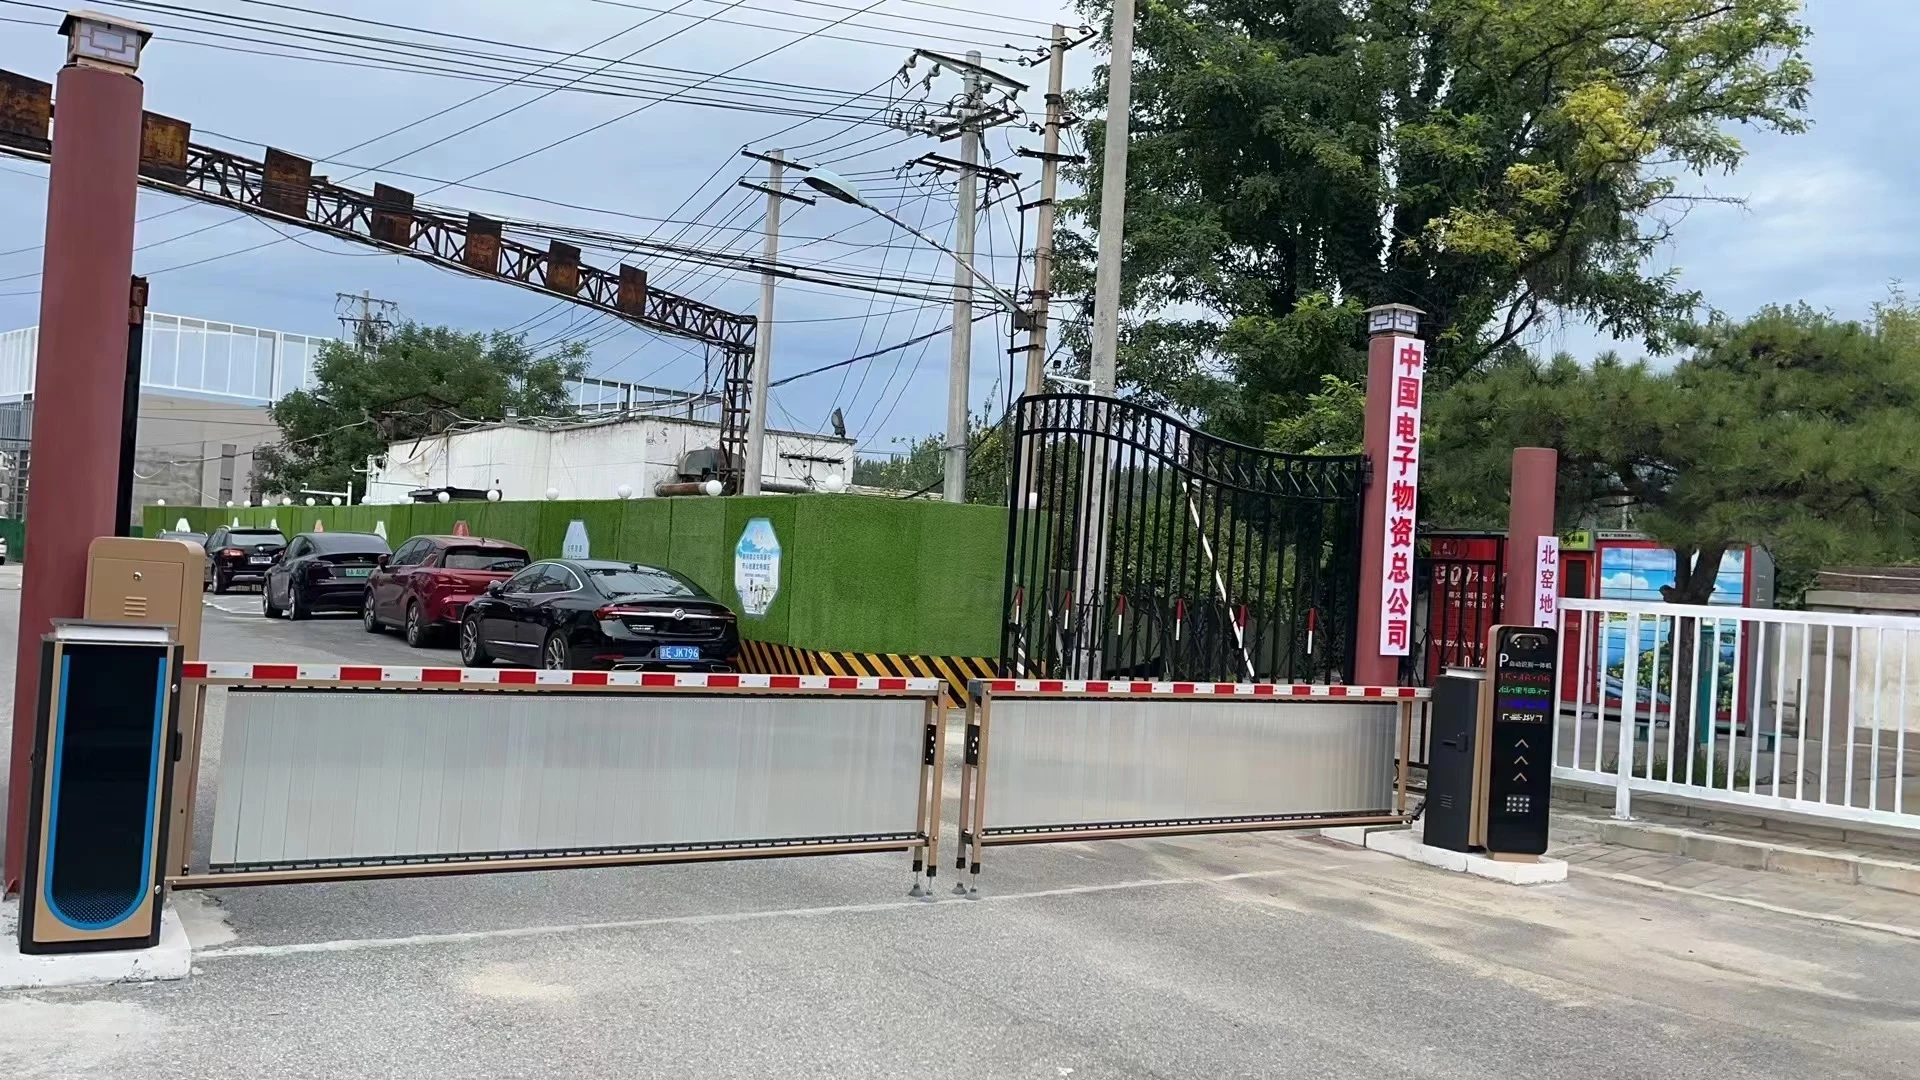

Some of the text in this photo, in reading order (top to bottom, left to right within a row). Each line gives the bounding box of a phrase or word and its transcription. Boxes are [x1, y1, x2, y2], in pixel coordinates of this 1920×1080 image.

[1387, 343, 1421, 650] 中国电子物资总公司
[1499, 653, 1509, 668] P
[1509, 660, 1552, 669] 自动识别一体机
